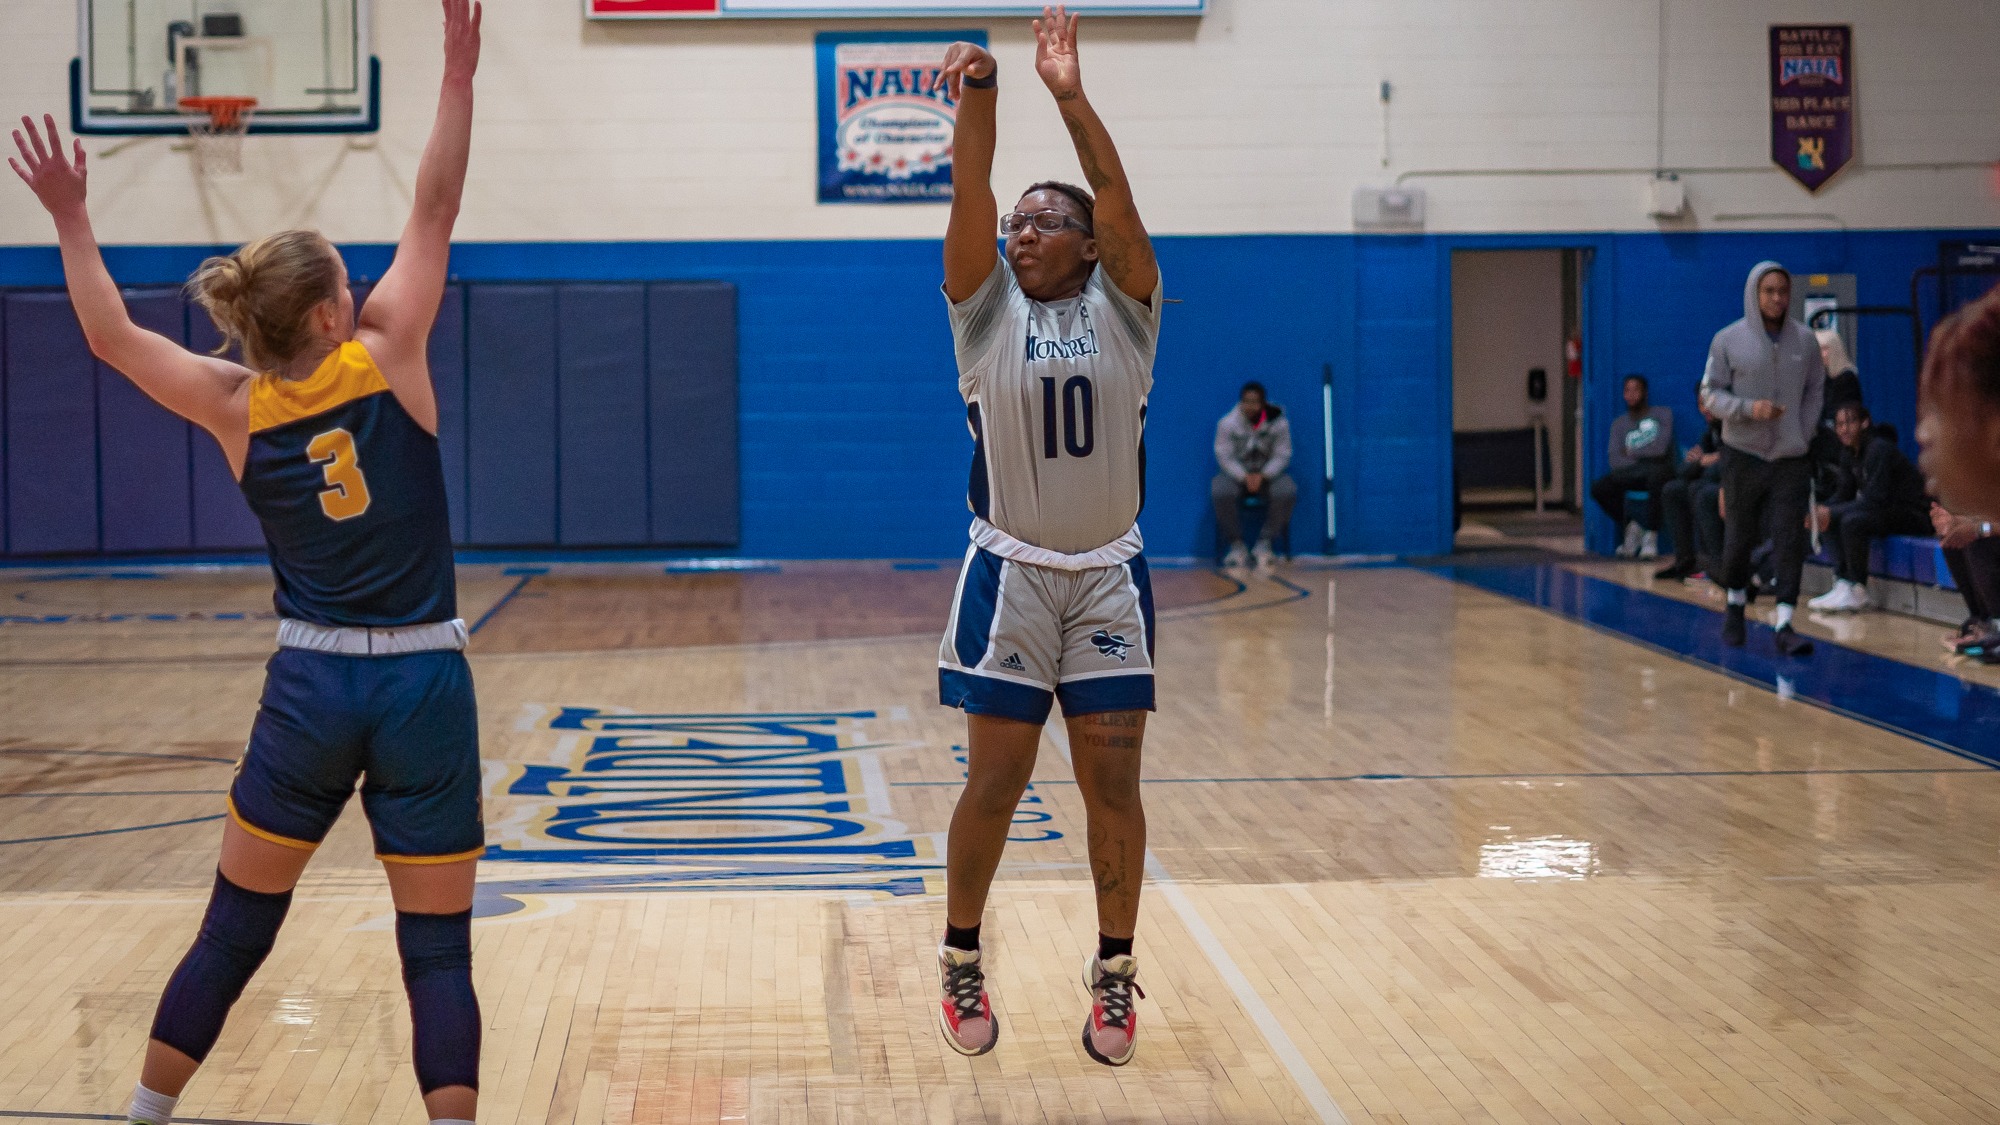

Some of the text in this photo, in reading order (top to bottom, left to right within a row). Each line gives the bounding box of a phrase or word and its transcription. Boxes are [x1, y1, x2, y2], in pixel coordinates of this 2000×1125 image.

[845, 69, 956, 109] NAIA
[1783, 59, 1839, 80] NAIA
[1039, 375, 1094, 459] 10
[306, 427, 371, 521] 3
[1000, 661, 1026, 671] adidas
